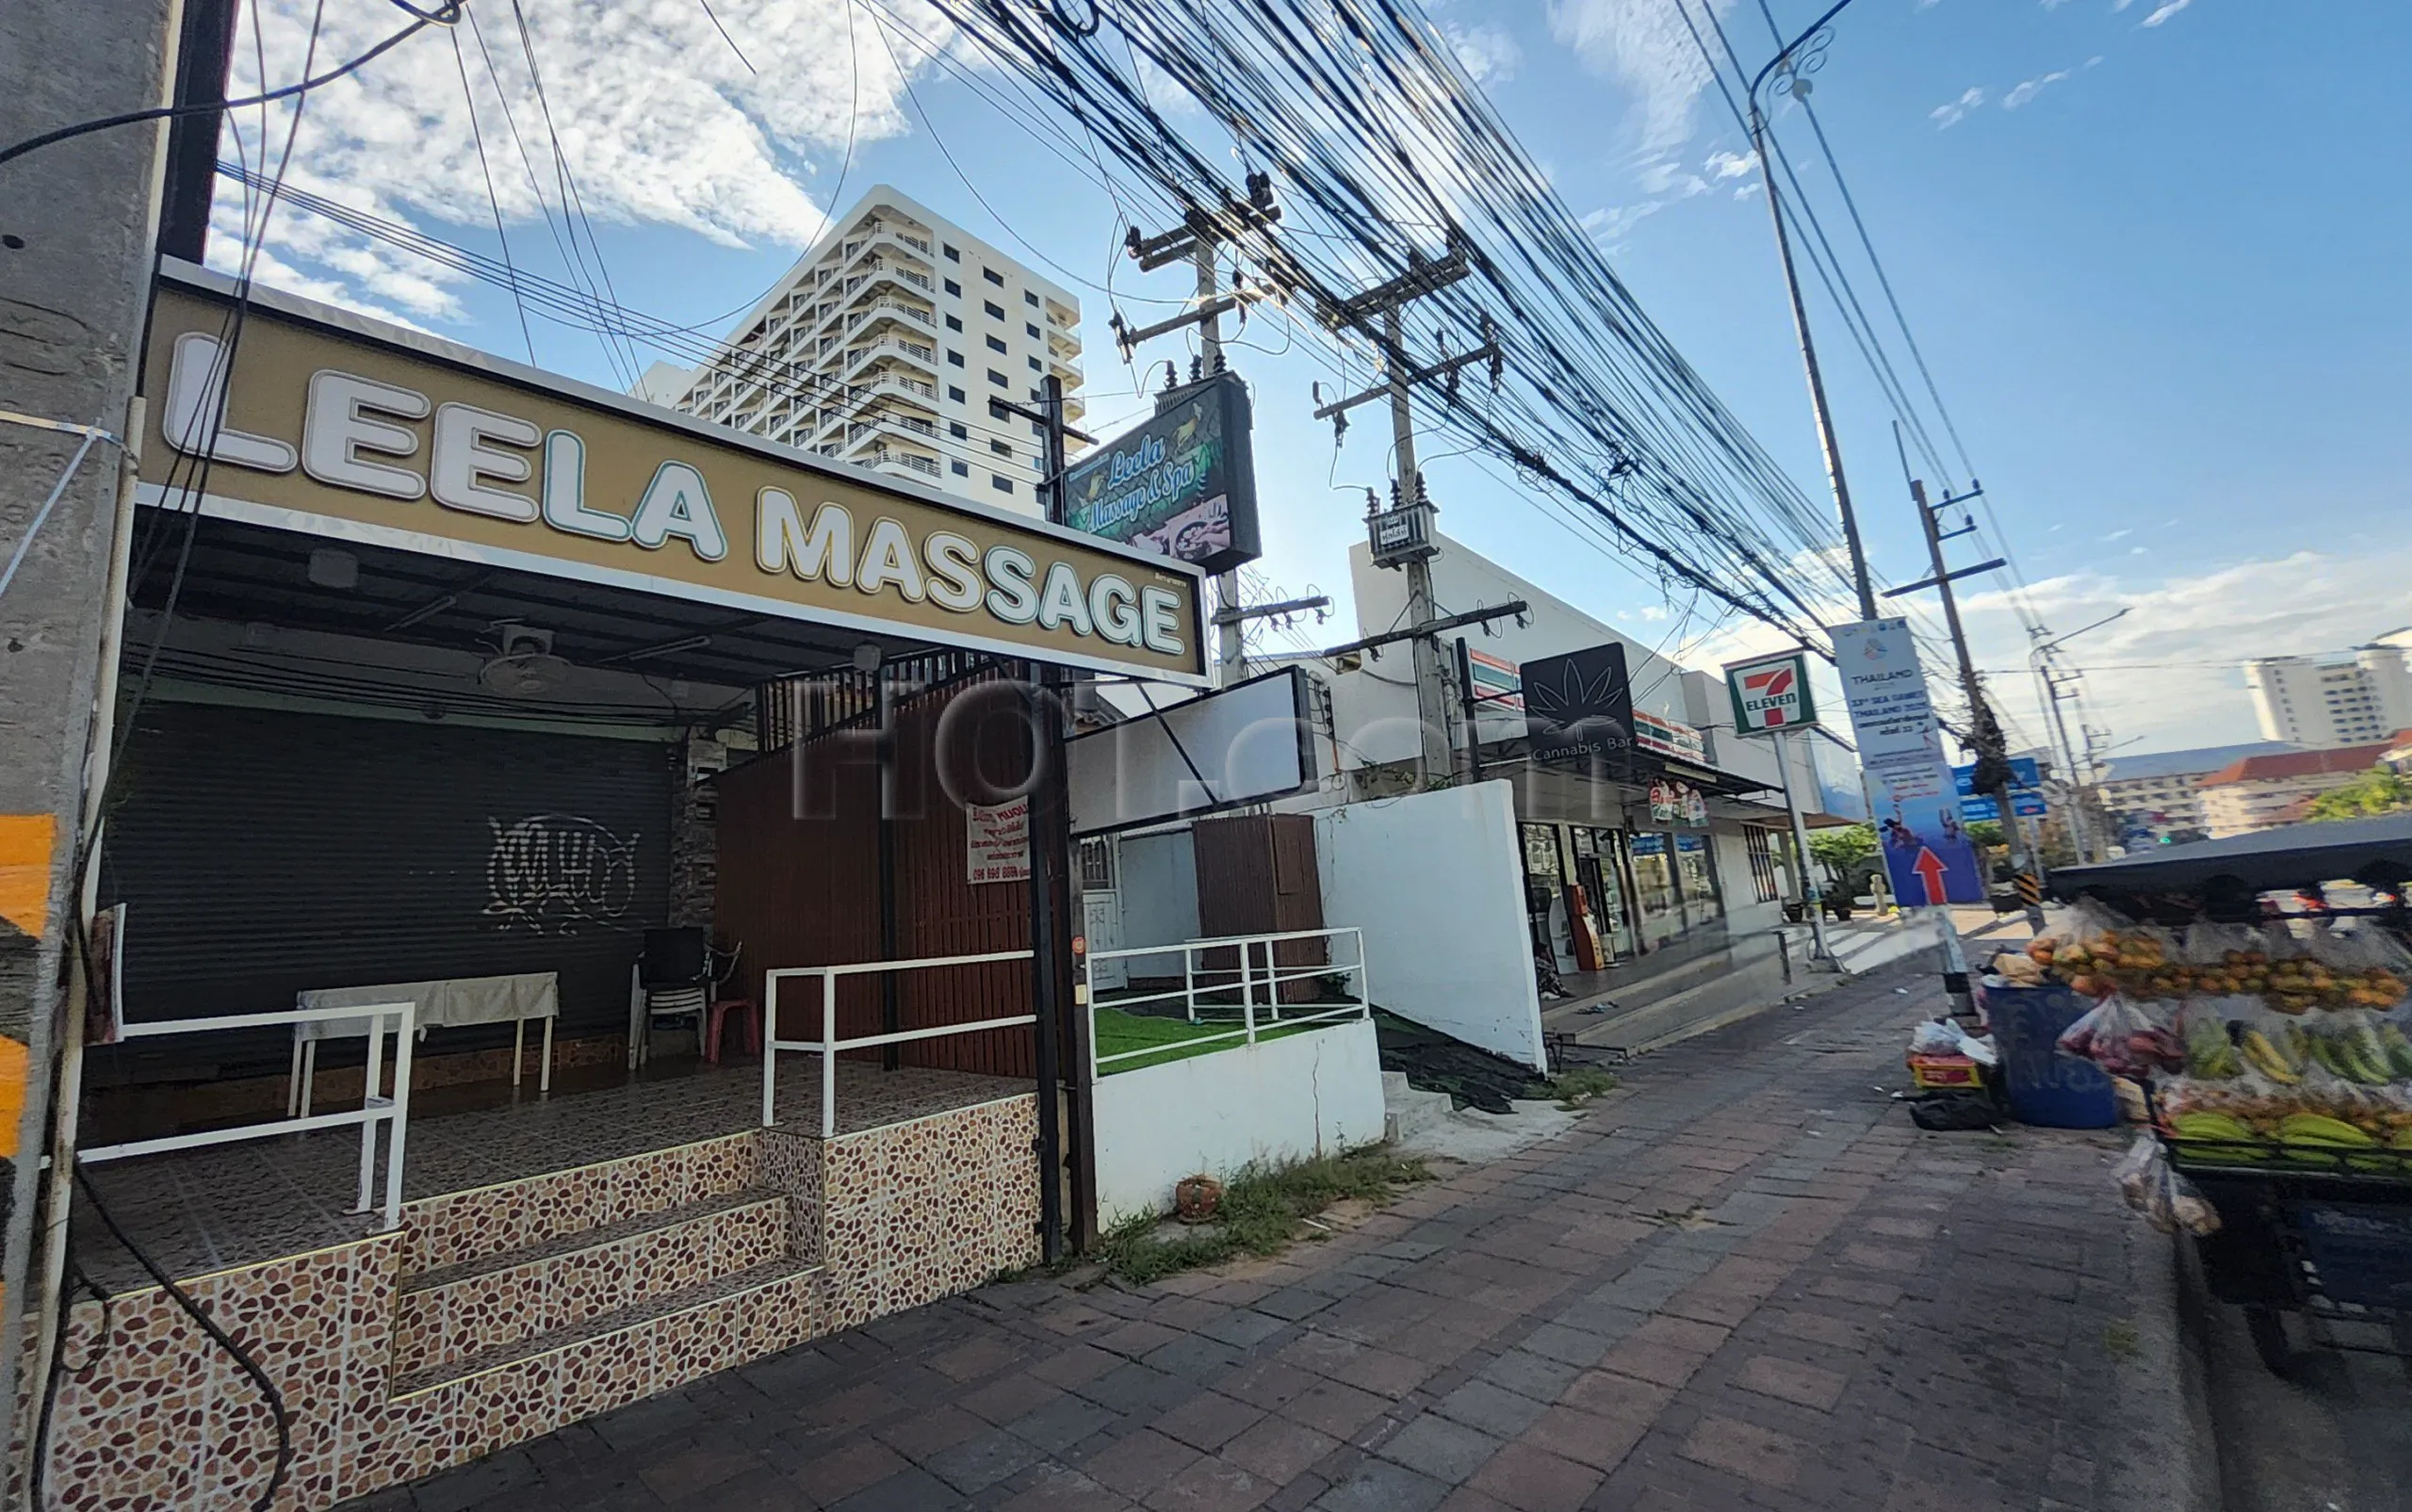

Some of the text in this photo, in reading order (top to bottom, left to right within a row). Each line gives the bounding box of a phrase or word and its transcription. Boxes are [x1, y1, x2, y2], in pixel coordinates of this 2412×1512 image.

[162, 331, 1185, 656] LEELA MASSAGE
[1108, 434, 1165, 491] Leela
[1087, 462, 1195, 534] Massage & Spa
[1532, 737, 1633, 761] Cannabis Bar
